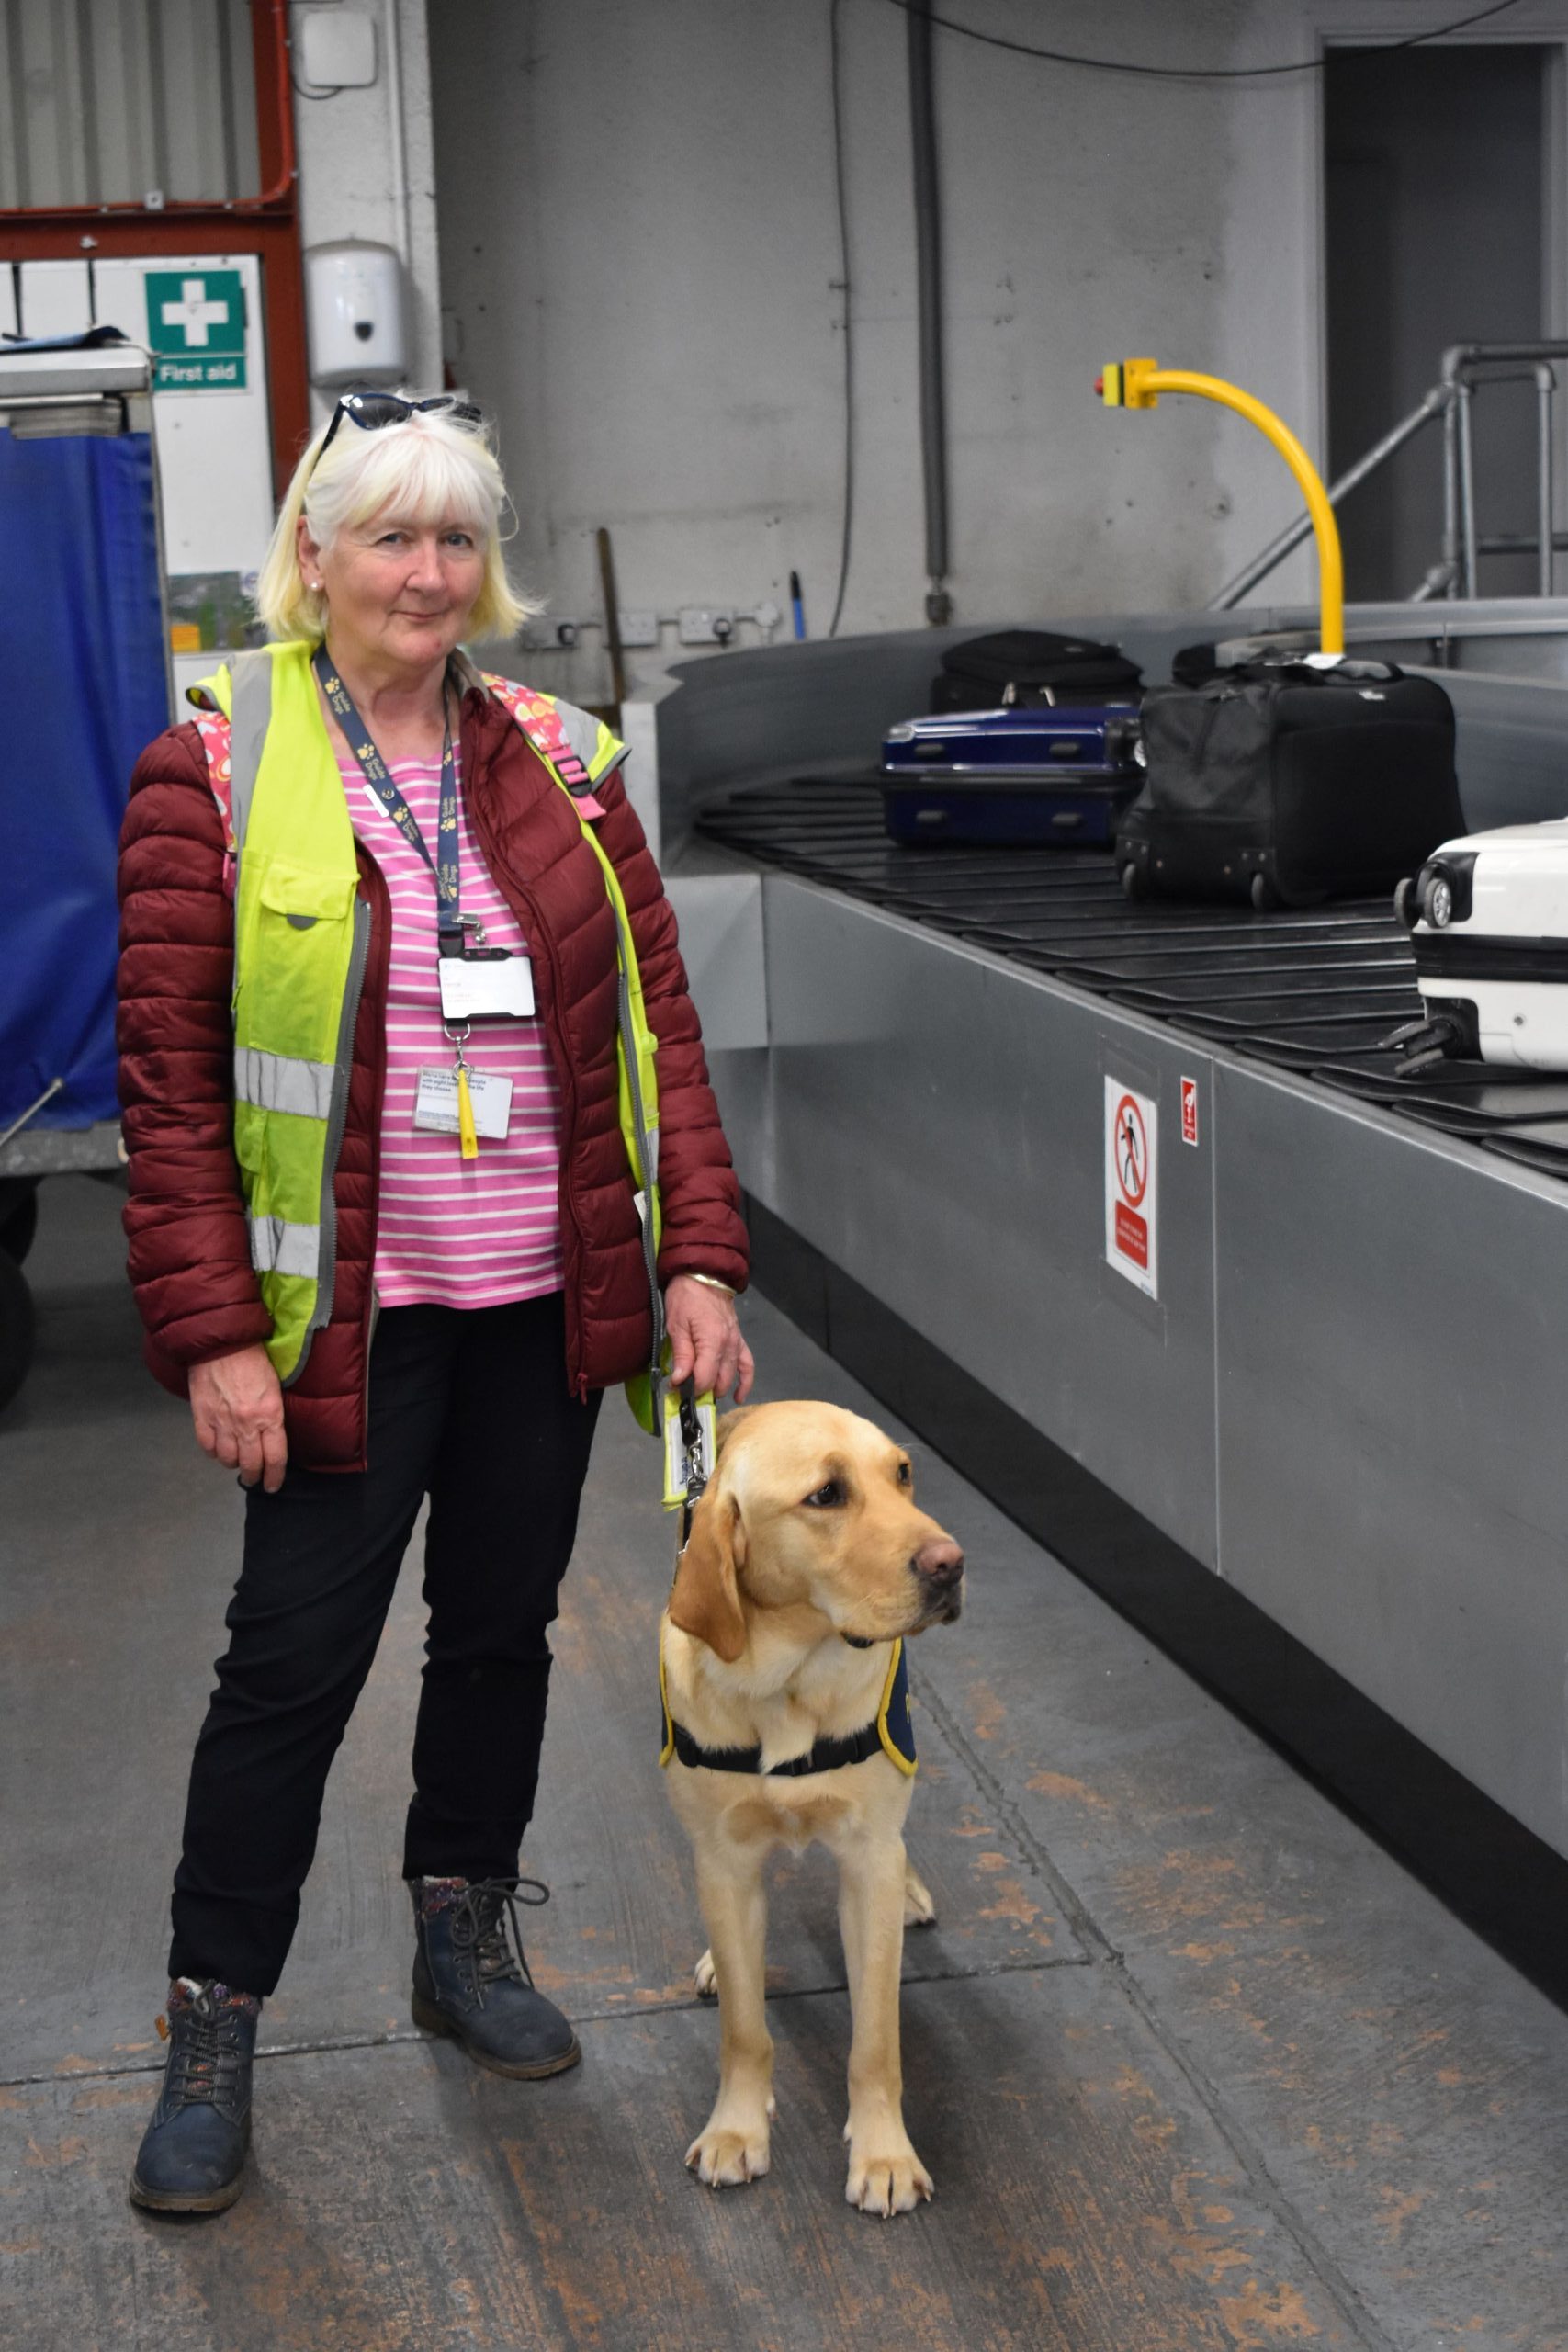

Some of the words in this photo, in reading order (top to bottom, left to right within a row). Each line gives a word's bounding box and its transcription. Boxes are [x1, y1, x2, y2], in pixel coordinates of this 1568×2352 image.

[161, 363, 203, 382] First
[207, 363, 236, 380] aid
[332, 695, 344, 715] Dogs
[337, 691, 350, 712] Guide
[365, 762, 378, 780] Dogs
[372, 758, 385, 779] Guide
[449, 865, 457, 883] Dogs
